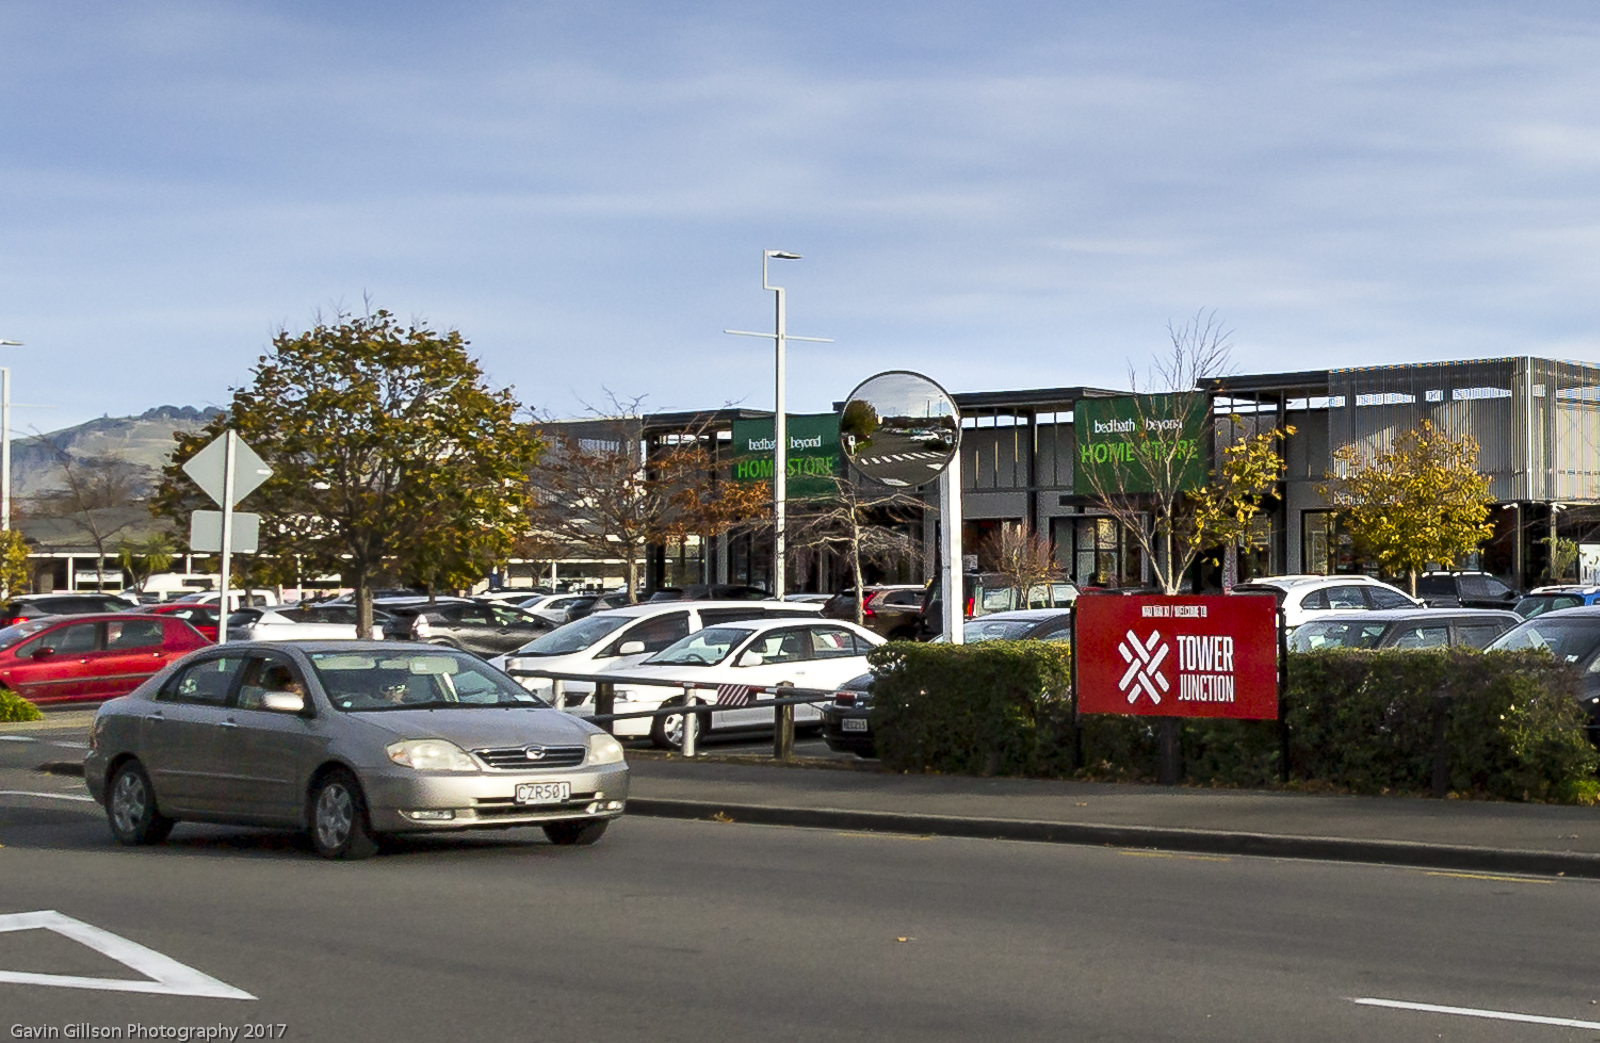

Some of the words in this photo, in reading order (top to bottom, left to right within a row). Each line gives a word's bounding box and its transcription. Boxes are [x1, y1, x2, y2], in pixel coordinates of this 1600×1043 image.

[790, 435, 822, 451] beyond
[1081, 442, 1136, 463] HOME
[737, 460, 774, 478] HOM
[787, 456, 833, 476] STORE
[1176, 635, 1234, 672] TOWER
[1178, 673, 1234, 702] JUNCTION
